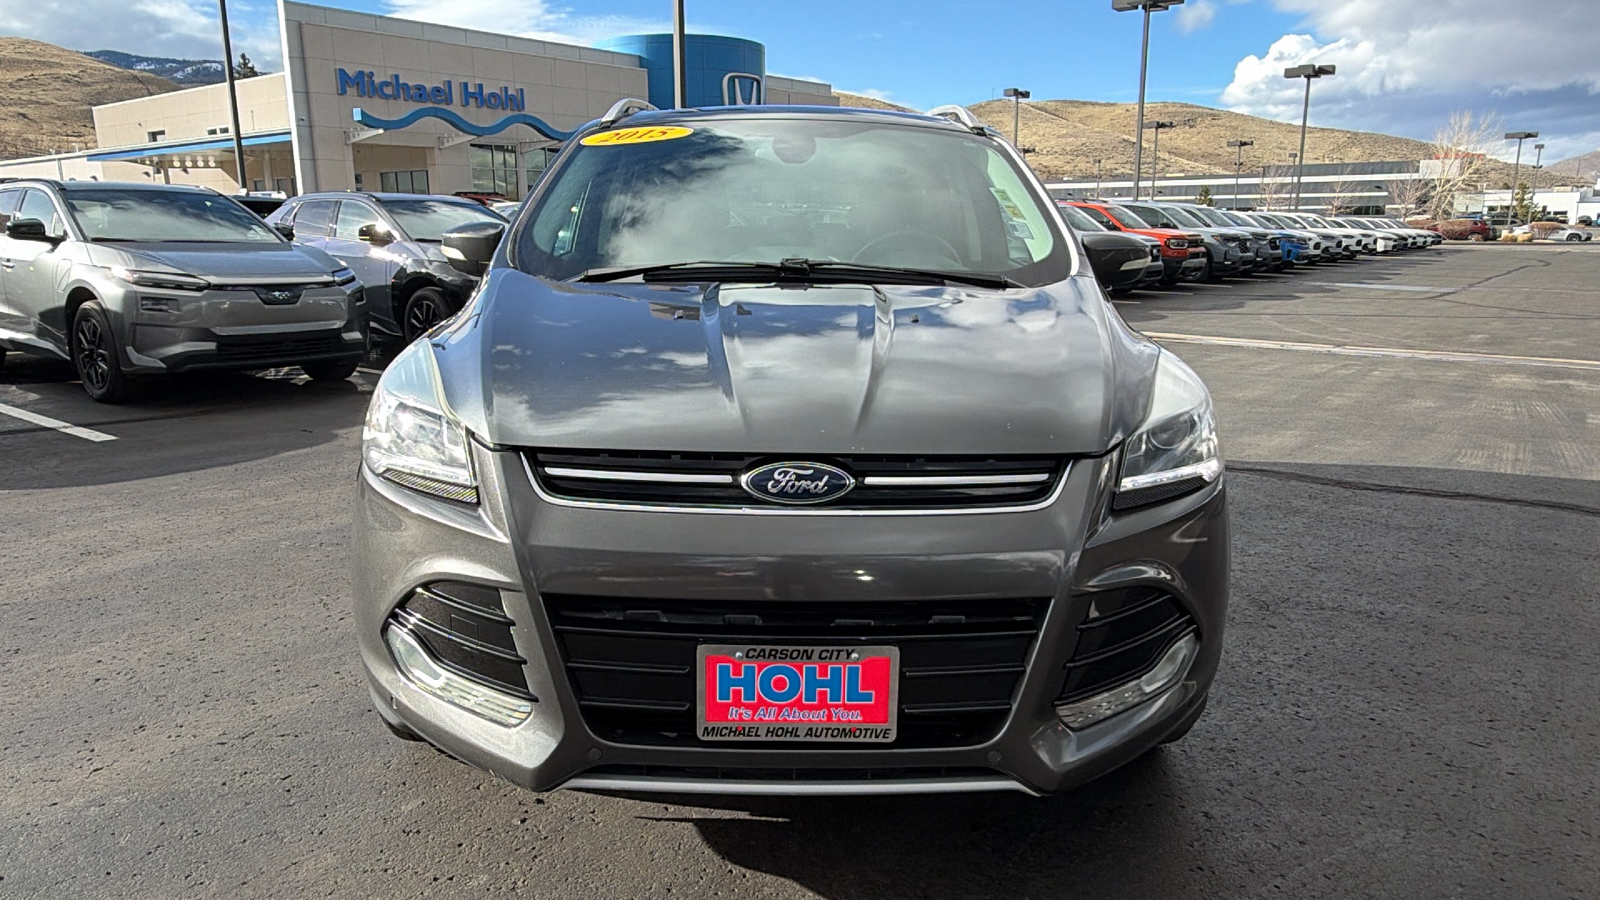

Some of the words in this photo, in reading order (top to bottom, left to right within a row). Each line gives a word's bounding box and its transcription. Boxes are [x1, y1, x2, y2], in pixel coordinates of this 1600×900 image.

[335, 67, 453, 105] Michael
[460, 81, 526, 111] Hohl
[596, 127, 676, 144] 2015
[767, 467, 829, 493] Ford
[745, 648, 812, 660] CARSON
[817, 649, 856, 660] CITY
[716, 663, 875, 704] HOHL
[728, 706, 752, 719] It's
[755, 706, 777, 719] All
[779, 707, 827, 720] About
[831, 708, 863, 720] You.
[702, 727, 762, 738] MICHAEL
[765, 727, 800, 738] HOHL
[804, 728, 892, 739] AUTOMOTIVE
